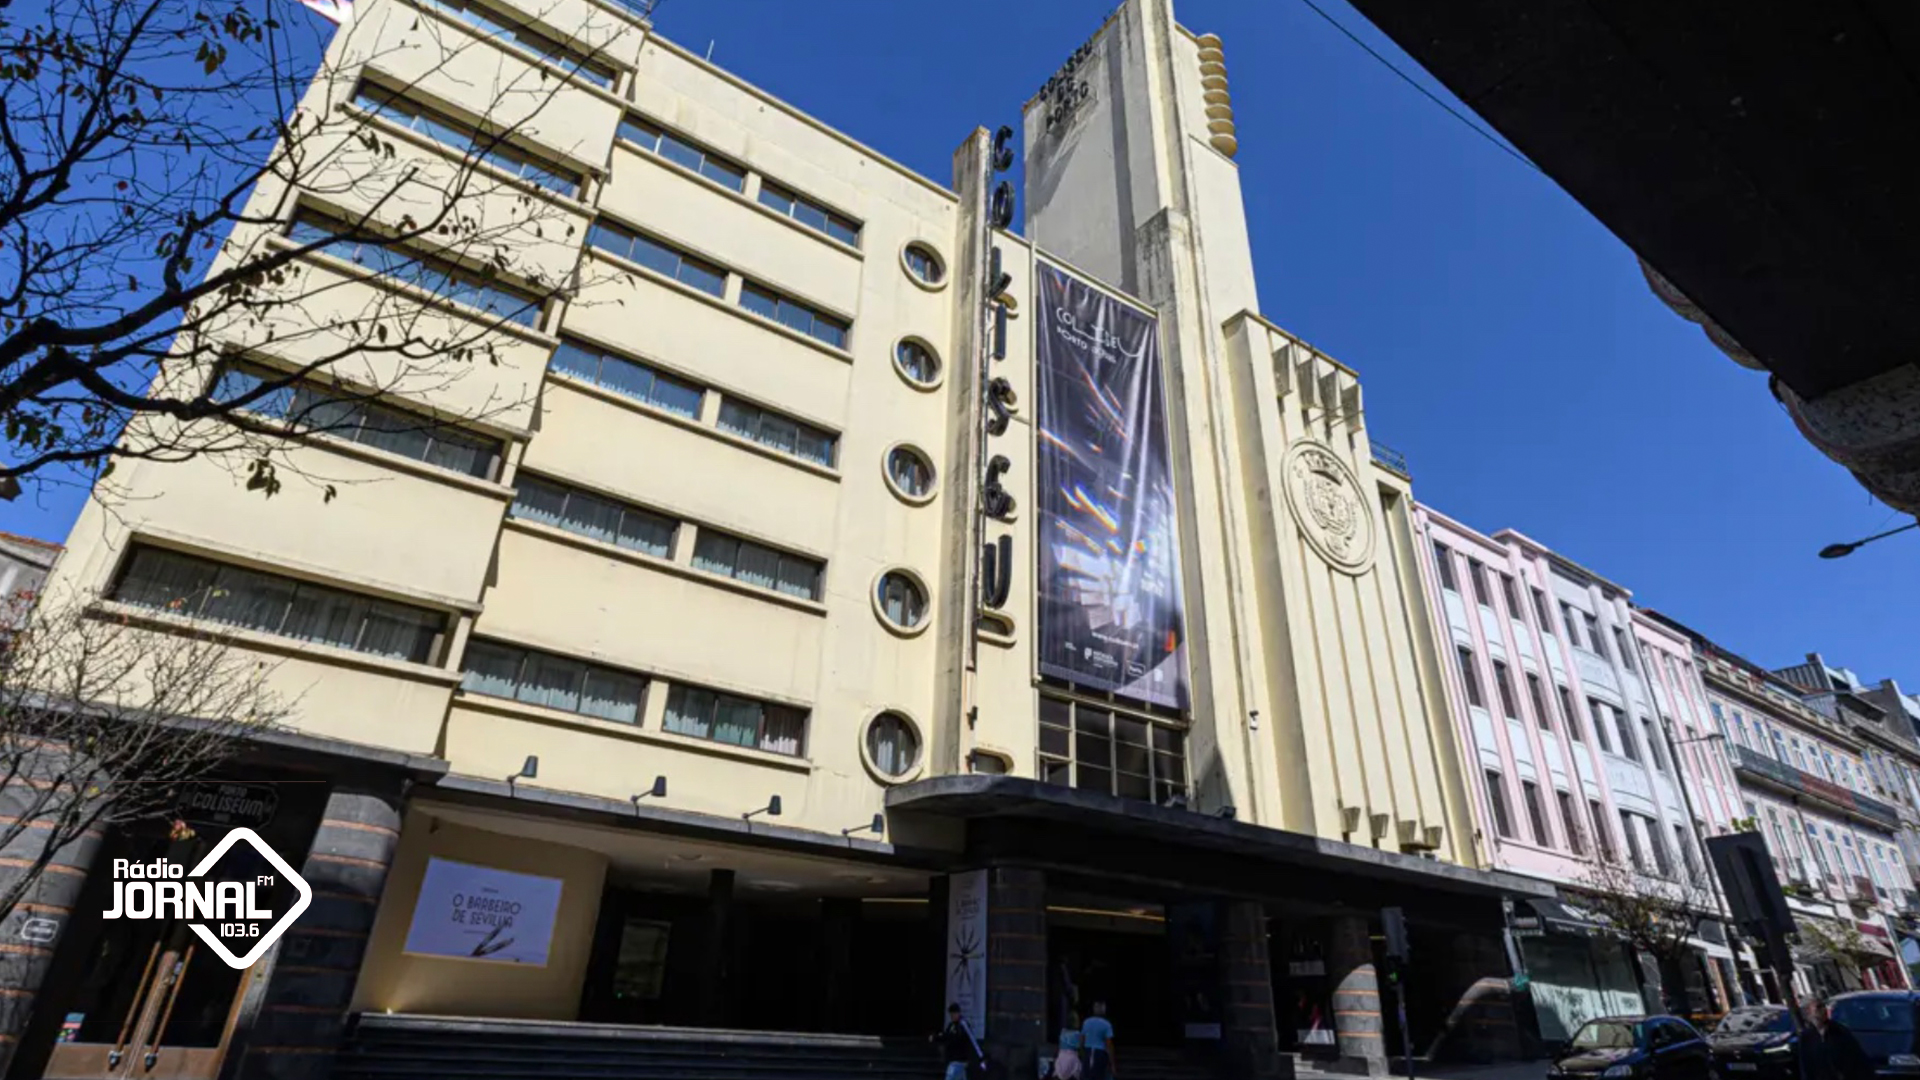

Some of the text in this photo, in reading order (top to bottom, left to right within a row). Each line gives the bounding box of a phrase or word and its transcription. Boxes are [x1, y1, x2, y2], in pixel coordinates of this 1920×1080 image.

[983, 125, 1014, 610] COLISEU
[192, 792, 263, 815] COLISEUM
[452, 893, 521, 915] O BARBEIRO
[452, 908, 467, 923] DE
